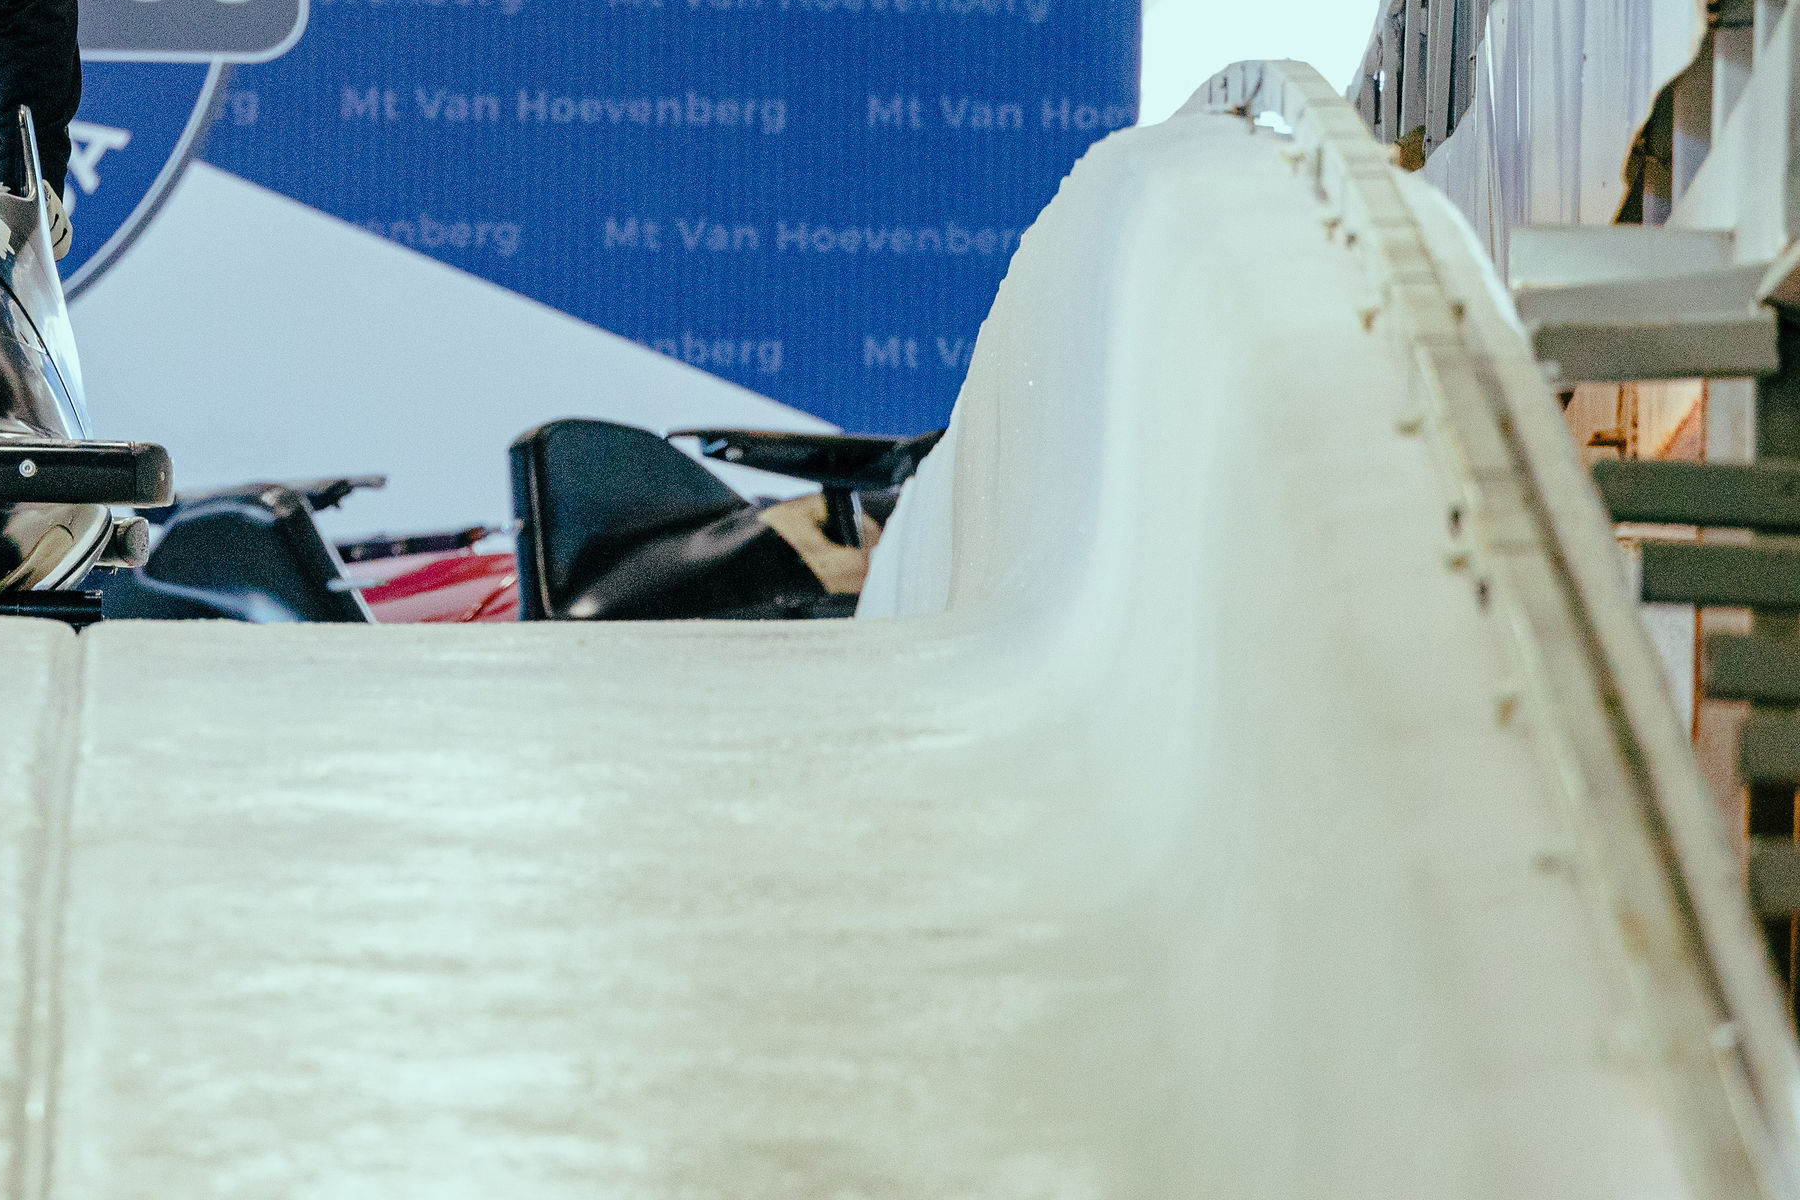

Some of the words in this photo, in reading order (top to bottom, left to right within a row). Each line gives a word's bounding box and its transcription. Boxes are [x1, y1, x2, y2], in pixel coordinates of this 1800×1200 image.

[340, 86, 399, 122] Mt
[415, 86, 500, 122] Van
[516, 88, 787, 135] Hoevenberg
[867, 94, 922, 130] Mt
[940, 95, 1025, 130] Van
[604, 215, 661, 250] Mt
[676, 216, 760, 252] Van
[863, 335, 918, 369] Mt
